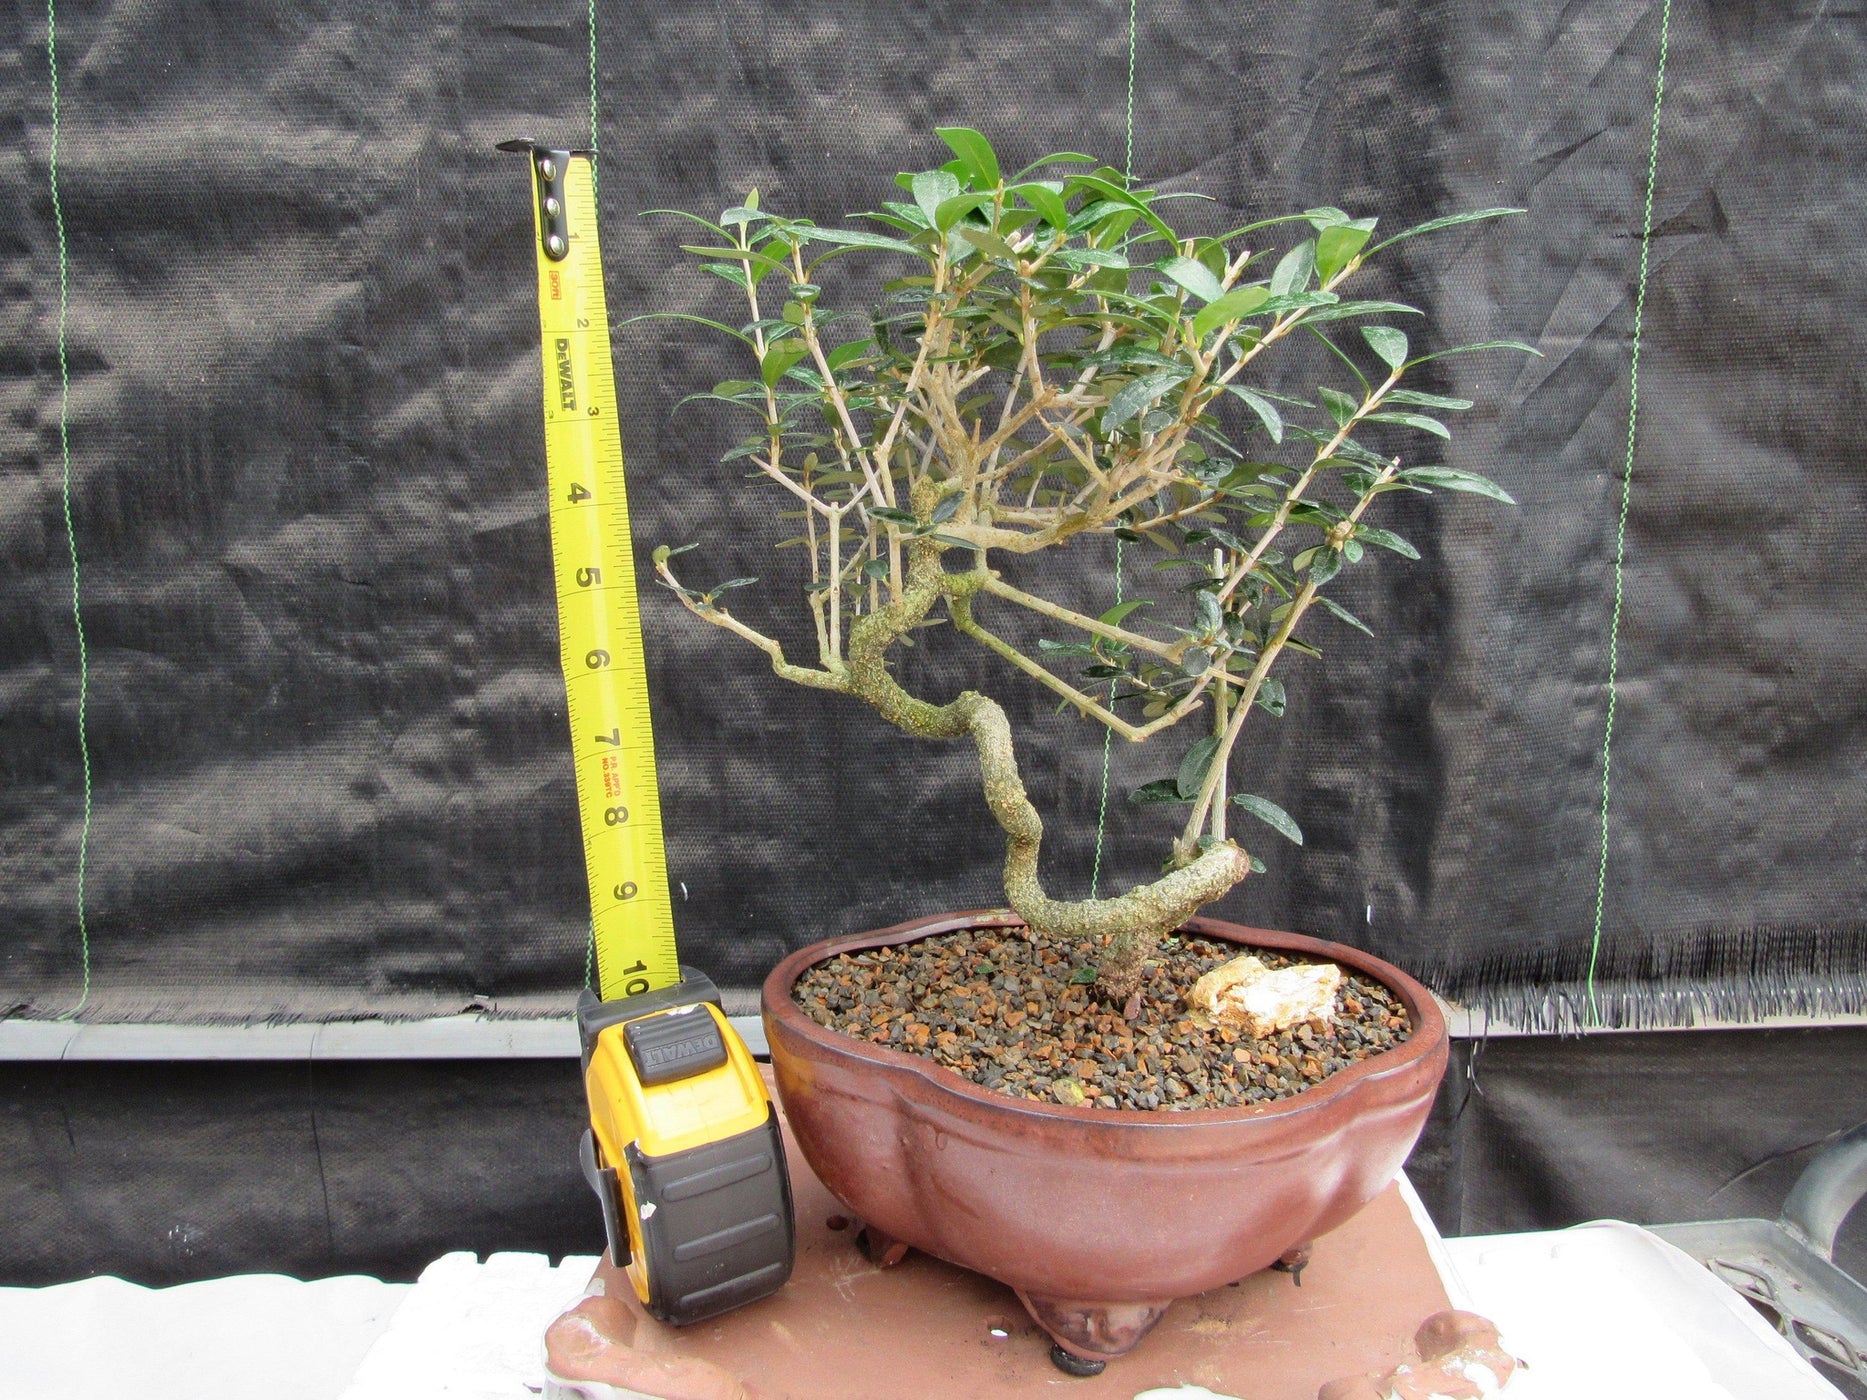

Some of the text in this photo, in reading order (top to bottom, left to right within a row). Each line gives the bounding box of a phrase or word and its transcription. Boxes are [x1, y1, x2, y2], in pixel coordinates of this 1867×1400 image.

[550, 271, 561, 300] 30ft
[576, 318, 590, 329] 2
[587, 406, 600, 417] 3
[567, 482, 592, 504] 4
[576, 567, 602, 588] 5
[585, 649, 611, 670] 6
[594, 727, 621, 746] 7
[604, 806, 629, 827] 8
[613, 881, 638, 901] 9
[623, 959, 650, 997] 10
